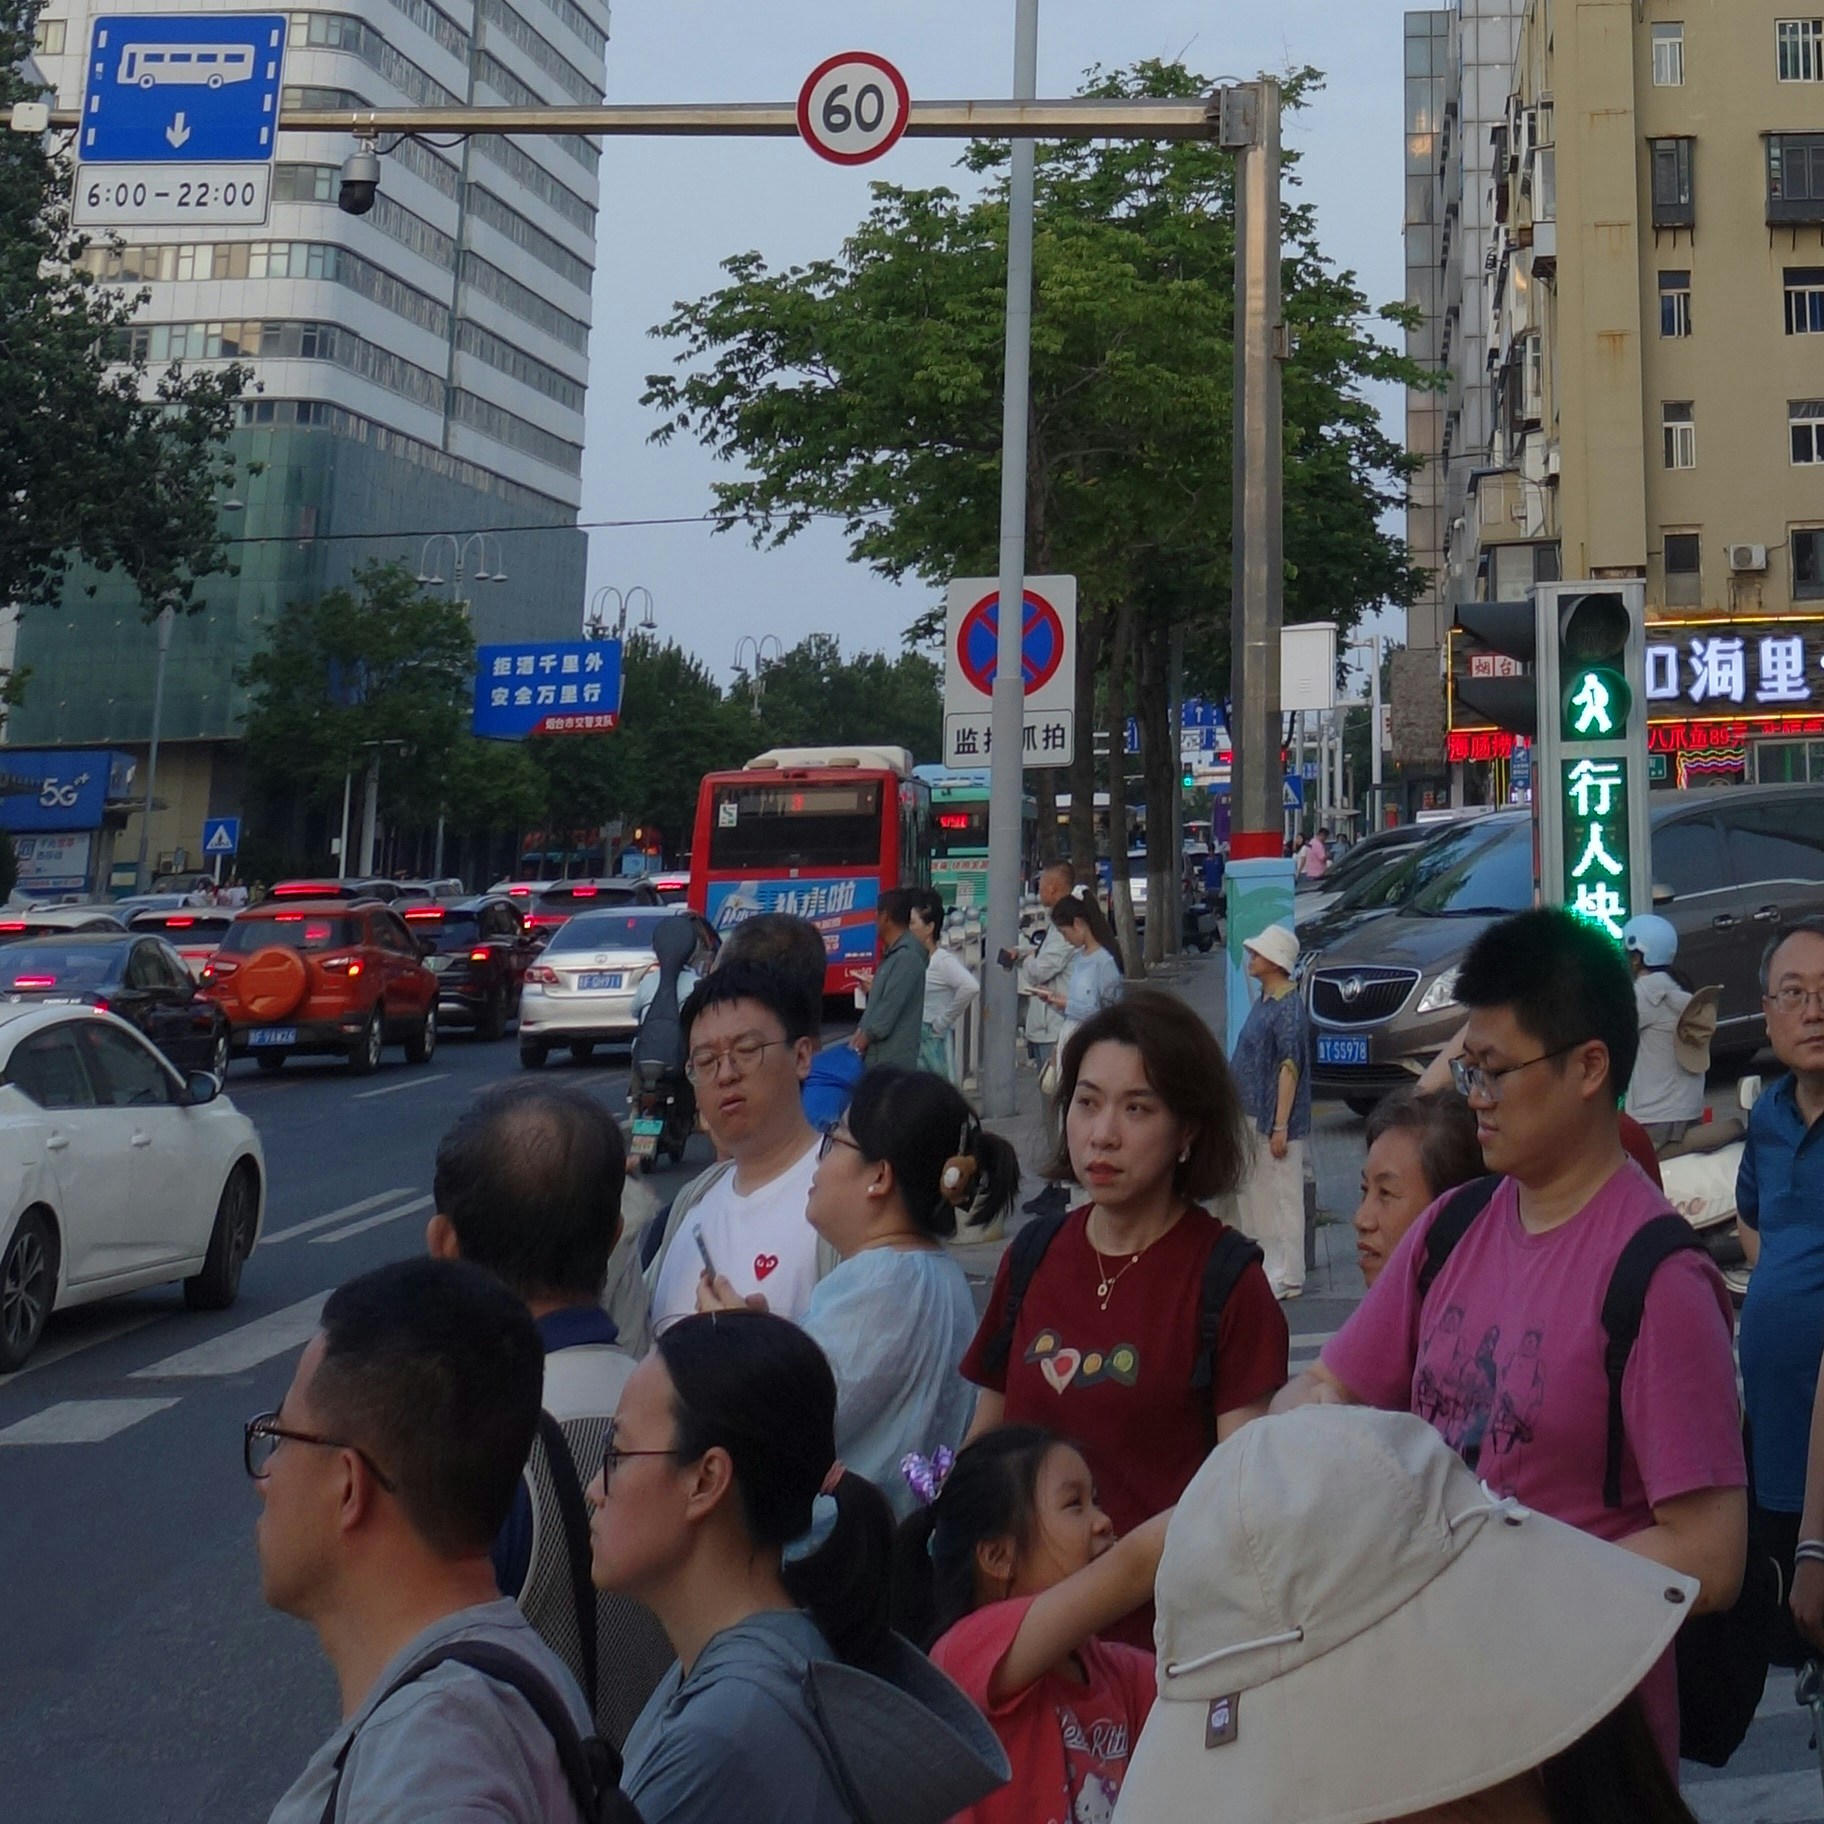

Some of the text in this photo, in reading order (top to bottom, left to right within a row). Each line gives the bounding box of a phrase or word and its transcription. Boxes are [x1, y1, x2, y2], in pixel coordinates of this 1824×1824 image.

[822, 83, 885, 134] 60
[492, 652, 604, 677] 拒酒千里外
[491, 682, 602, 707] 安全万里行
[545, 715, 613, 730] 烟台市交警支队
